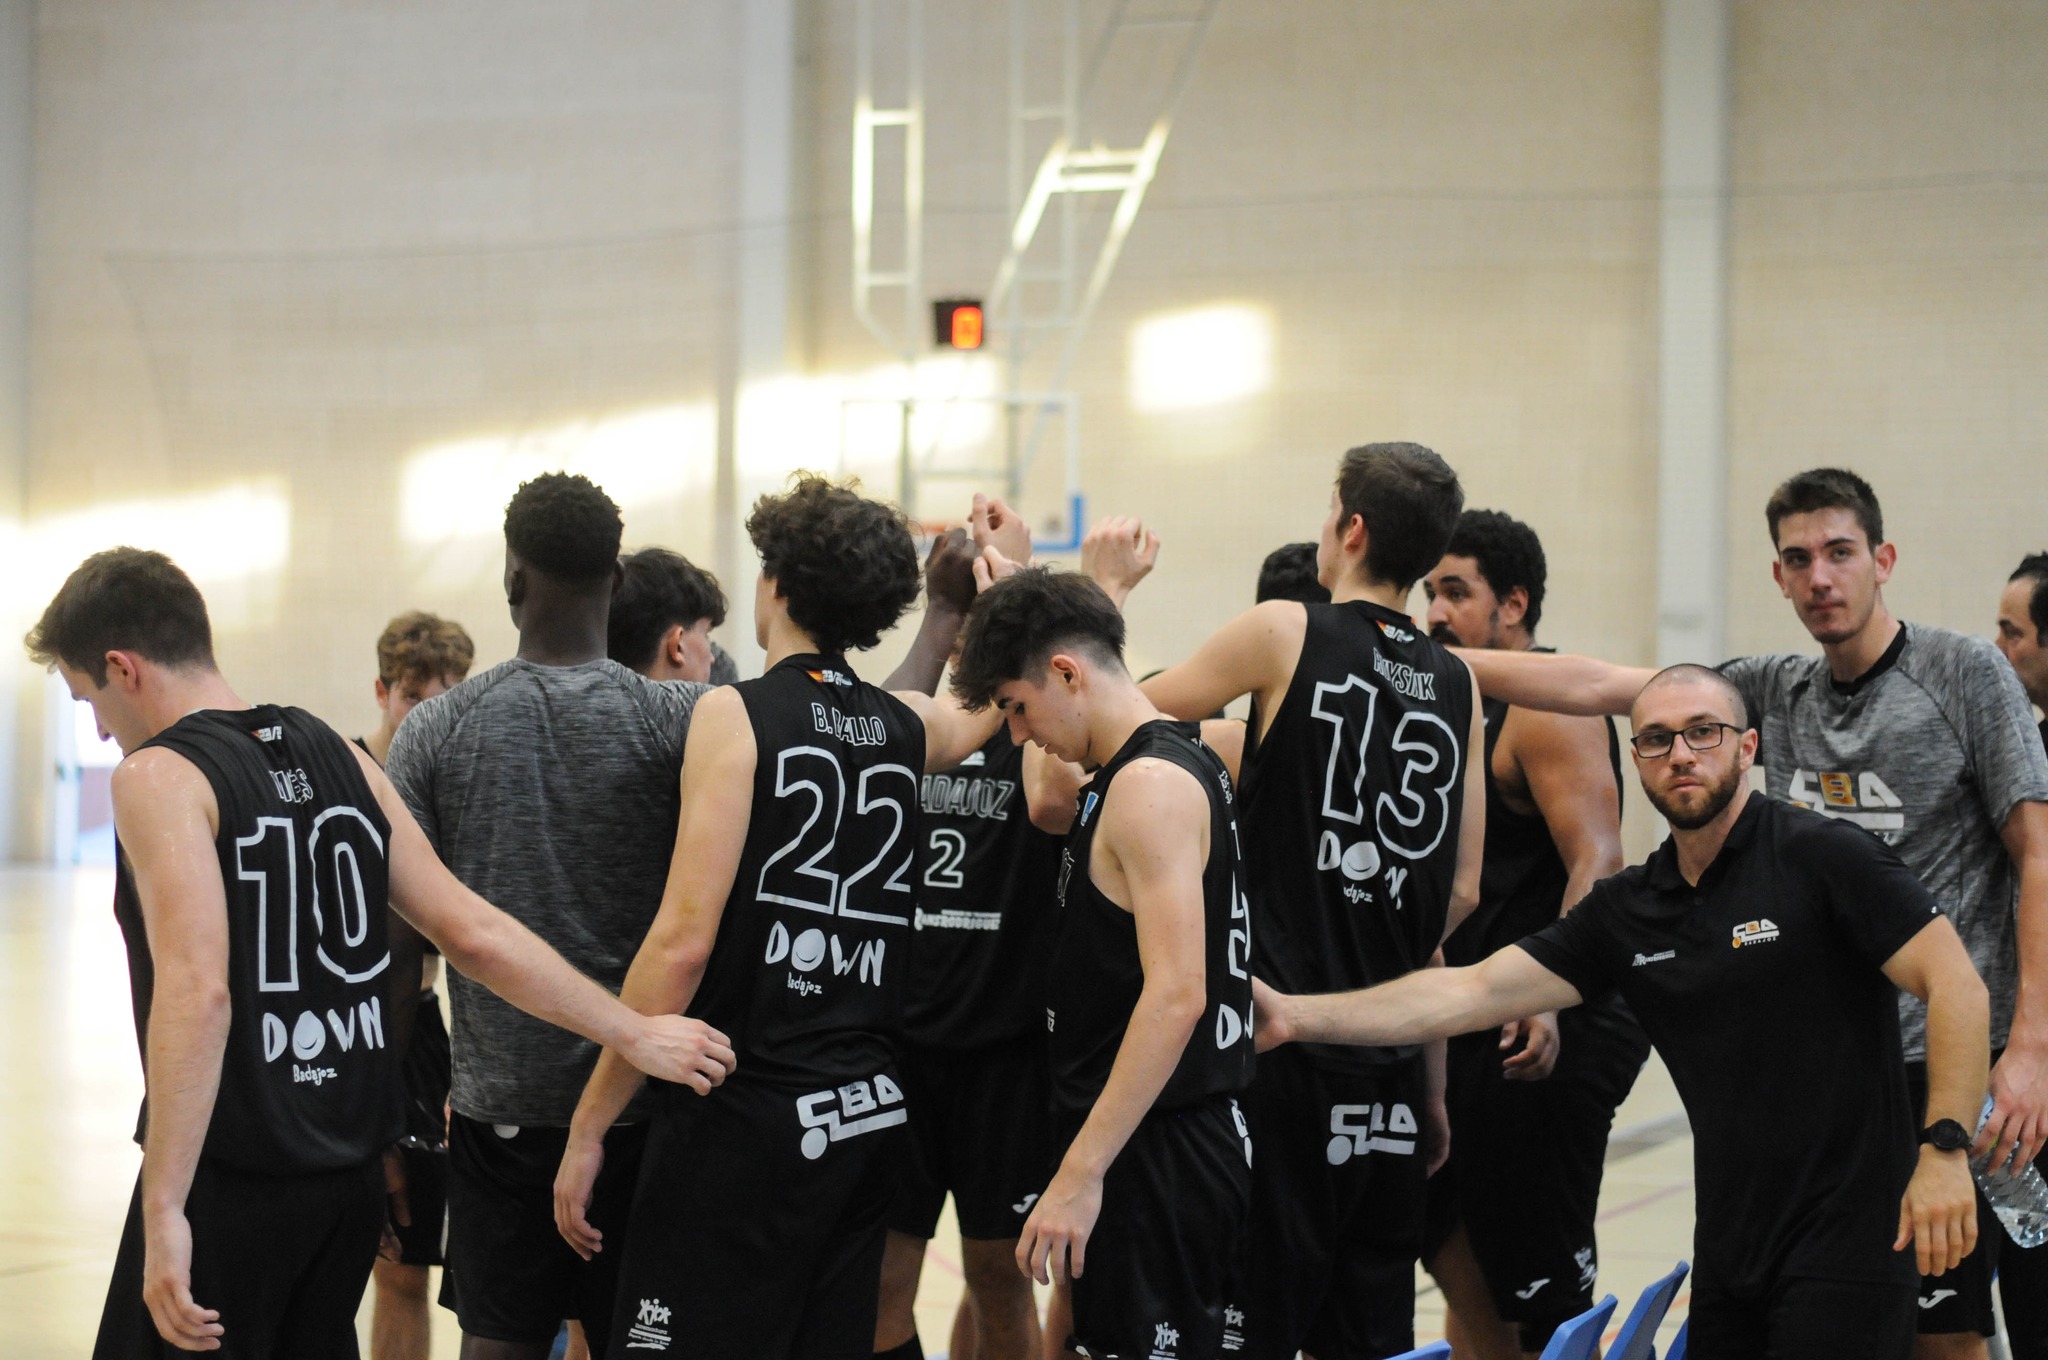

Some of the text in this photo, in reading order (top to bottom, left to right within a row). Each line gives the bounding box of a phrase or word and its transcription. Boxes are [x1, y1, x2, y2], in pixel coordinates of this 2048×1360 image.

[920, 774, 1015, 822] ADAJOZ
[1310, 673, 1460, 860] 13
[756, 745, 918, 927] 22
[923, 828, 967, 889] 2
[236, 805, 392, 993] 10
[764, 920, 886, 987] DOWN
